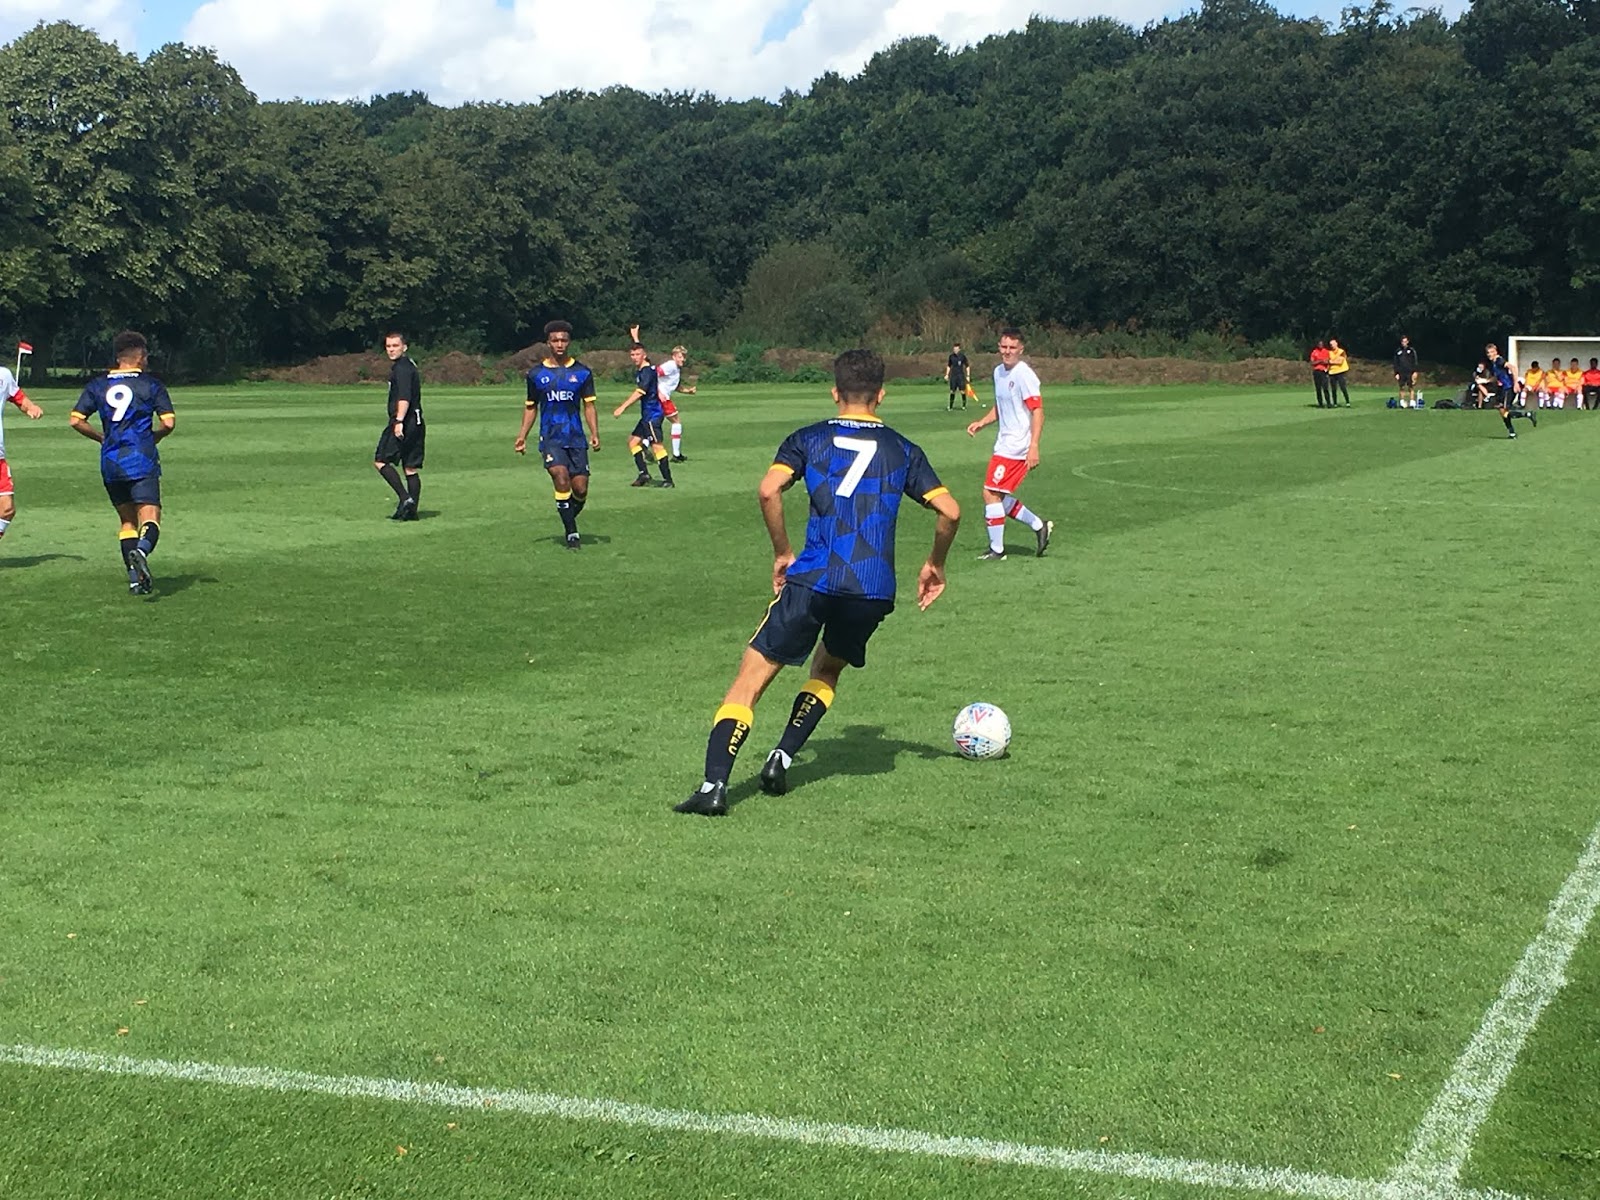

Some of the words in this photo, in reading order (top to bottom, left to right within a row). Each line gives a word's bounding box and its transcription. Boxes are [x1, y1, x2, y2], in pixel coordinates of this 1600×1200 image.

[106, 384, 133, 421] 9
[546, 390, 574, 402] LNER
[833, 436, 877, 498] 7
[994, 465, 1006, 480] 8
[728, 721, 748, 755] DRFC
